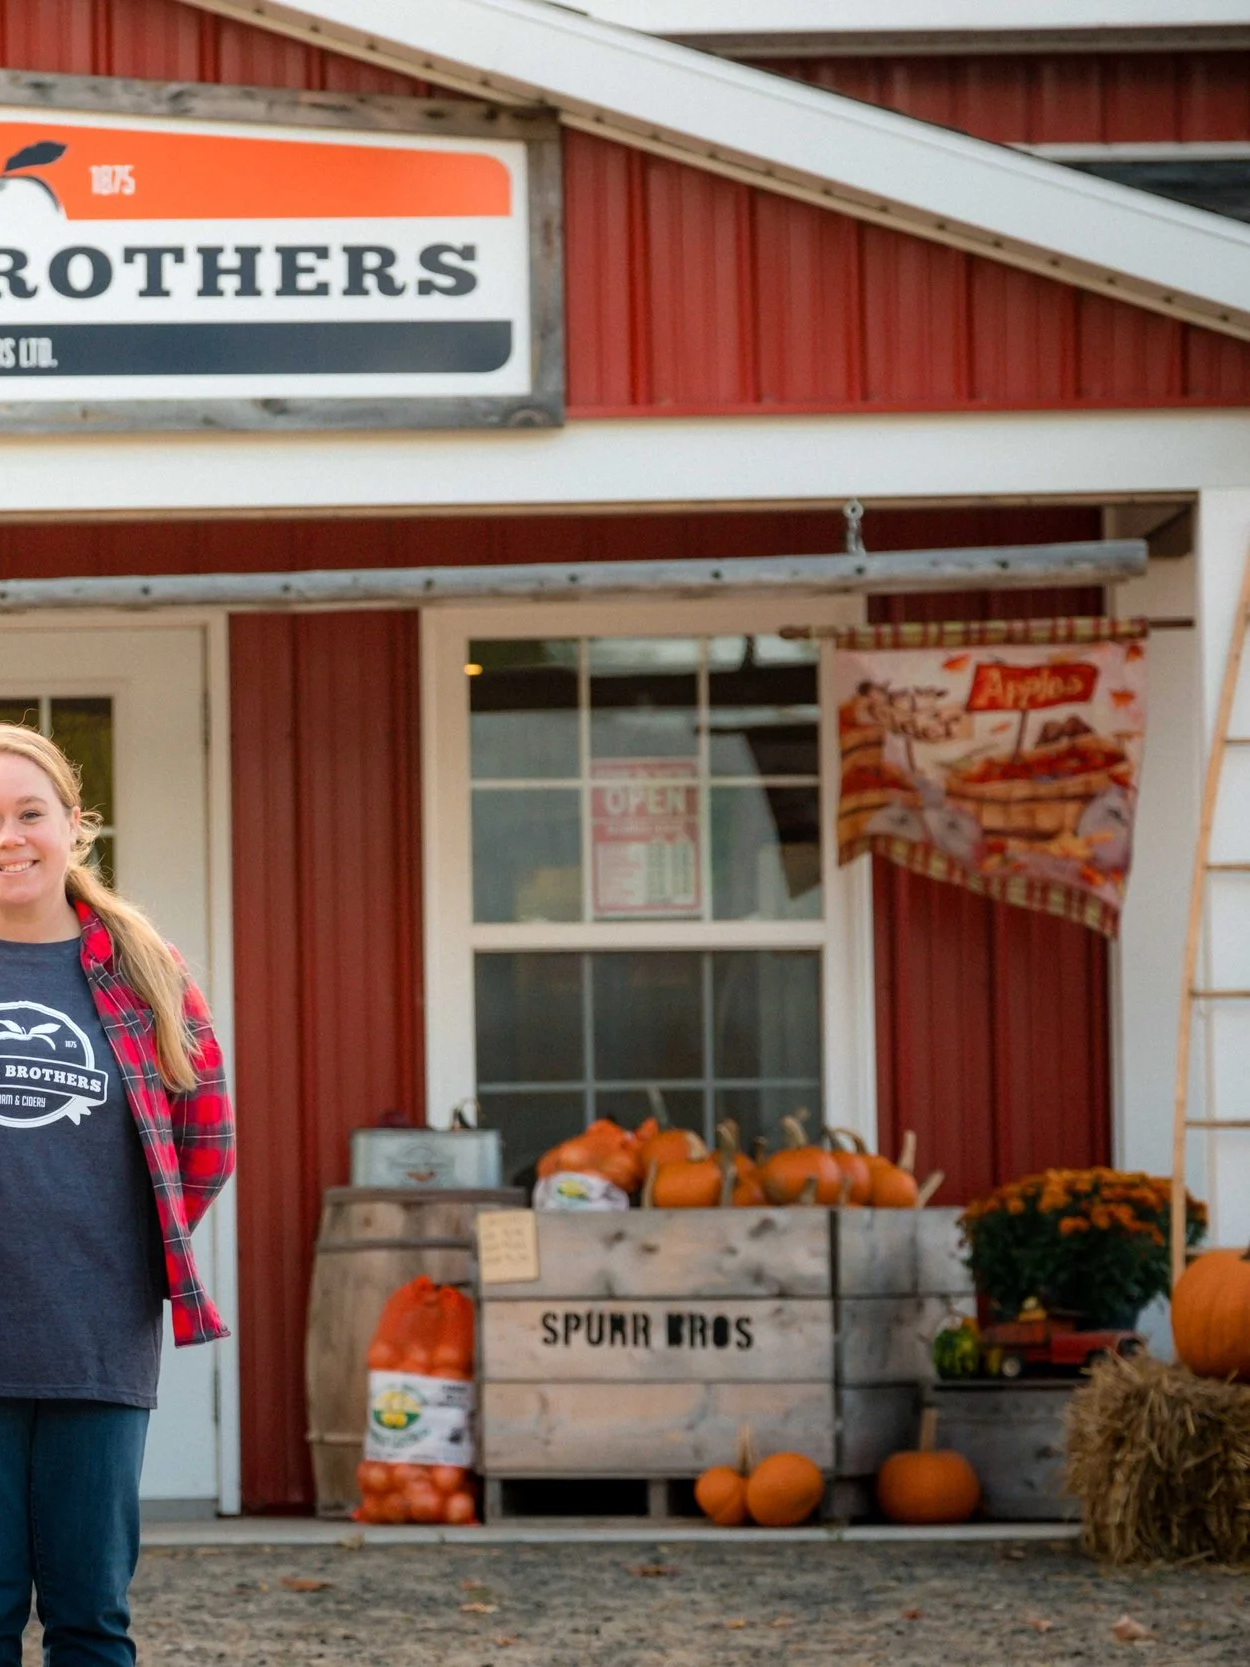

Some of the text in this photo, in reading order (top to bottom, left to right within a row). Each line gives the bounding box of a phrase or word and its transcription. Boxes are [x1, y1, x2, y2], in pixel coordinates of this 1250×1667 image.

[88, 164, 136, 196] 1875
[18, 337, 59, 368] LTD.
[64, 1040, 78, 1049] 1875
[5, 1064, 103, 1093] BROTHERS
[15, 1095, 20, 1106] &
[21, 1095, 47, 1108] CIDERY
[541, 1313, 754, 1350] SPURR BROS
